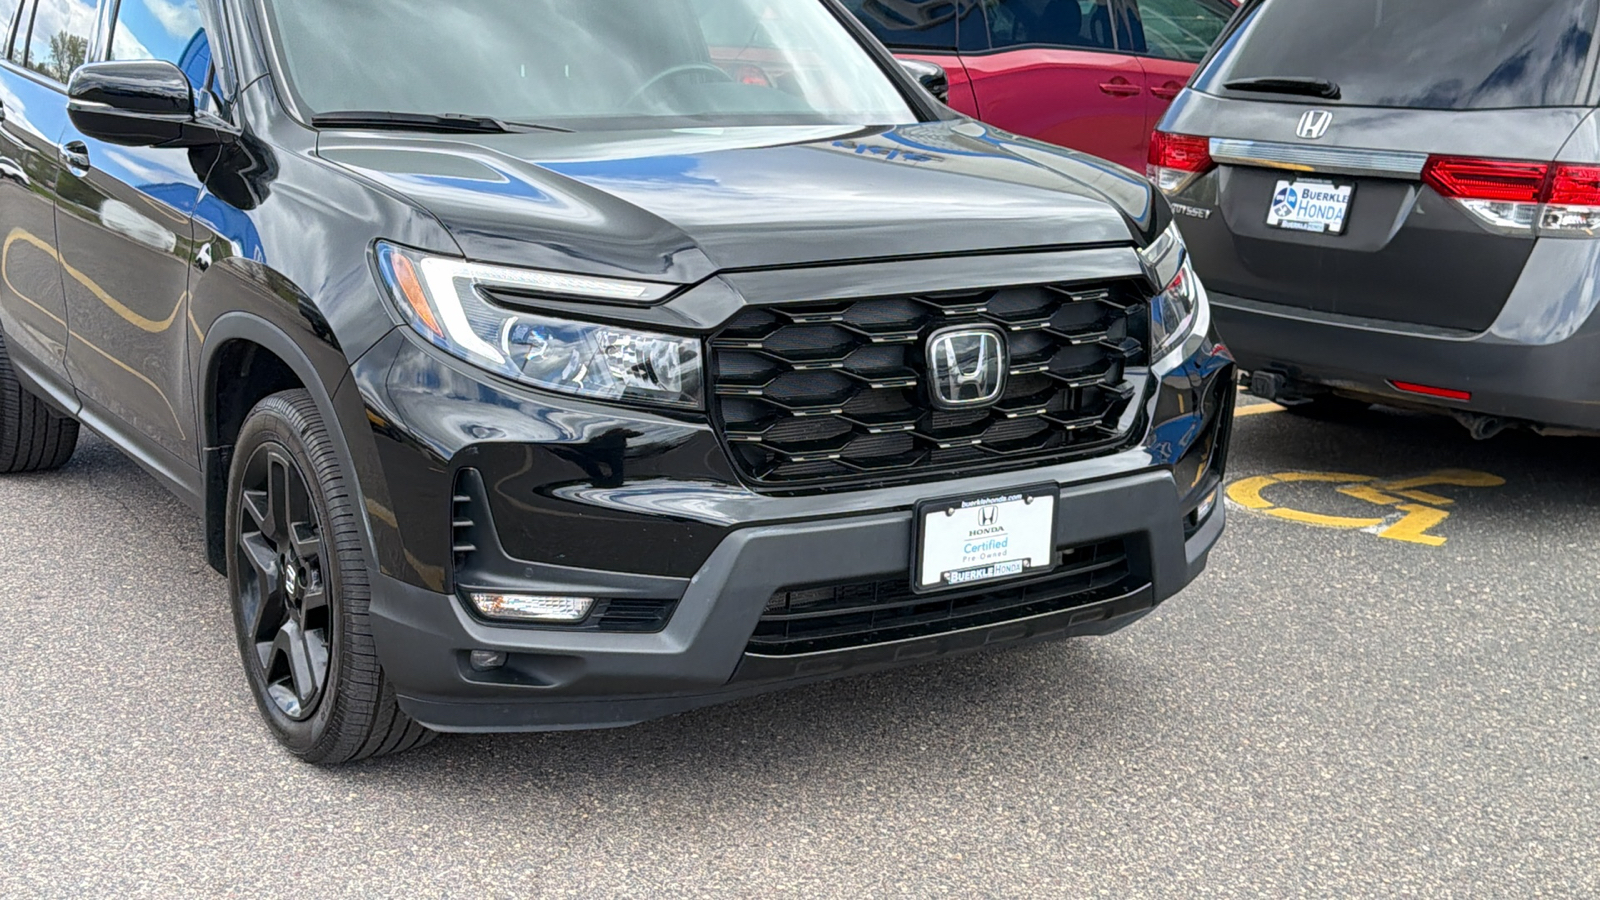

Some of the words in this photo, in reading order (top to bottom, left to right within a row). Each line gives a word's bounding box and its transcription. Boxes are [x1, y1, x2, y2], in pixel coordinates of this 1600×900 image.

[1302, 188, 1349, 204] BUERKLE
[1297, 200, 1343, 221] HONDA
[961, 494, 1022, 508] buerklehonda.com
[969, 526, 1005, 537] HONDA
[964, 537, 1008, 554] Certified
[951, 567, 994, 583] BUERKLE
[995, 563, 1021, 575] HONDA
